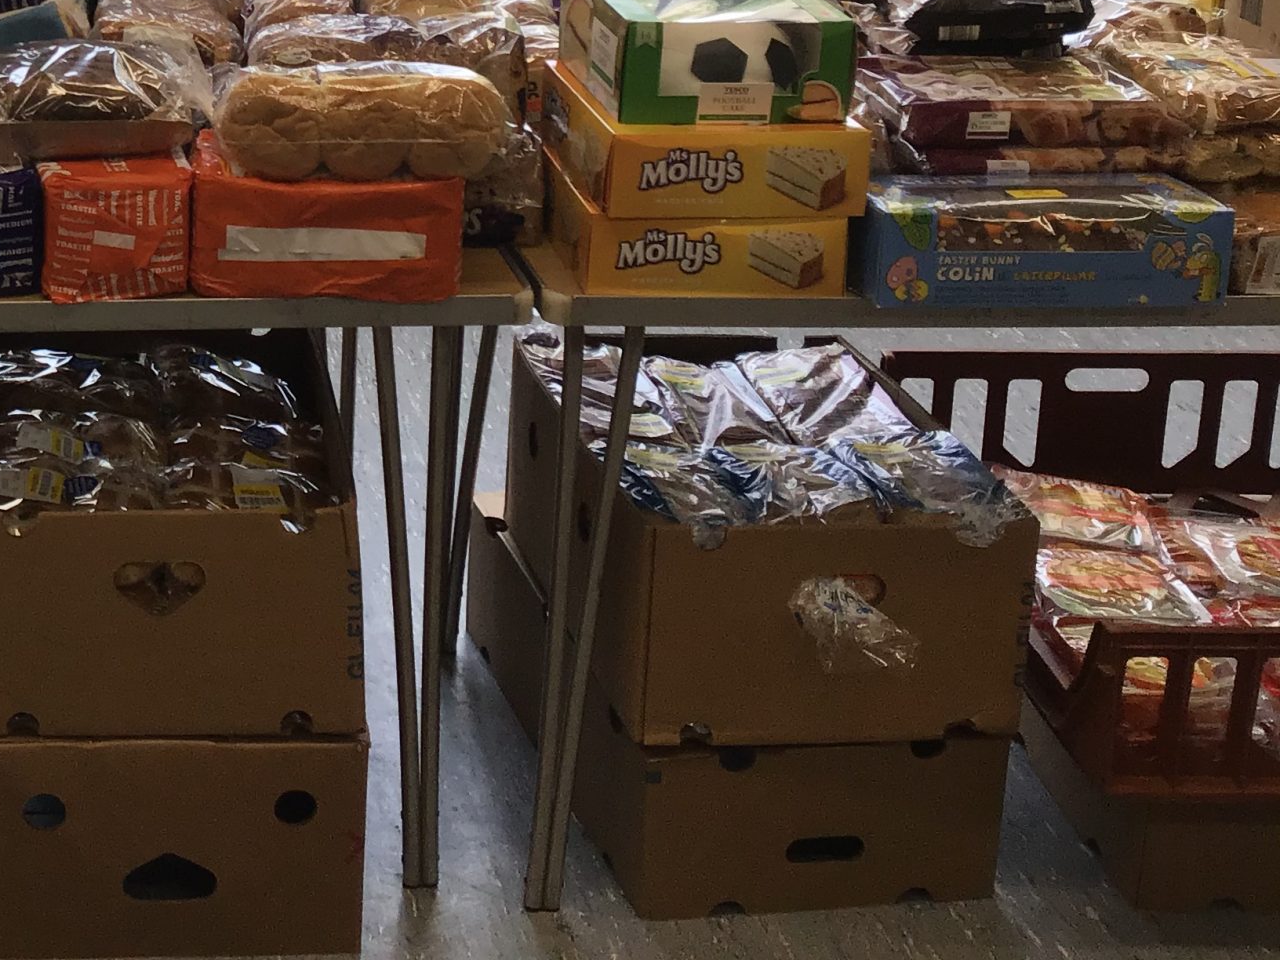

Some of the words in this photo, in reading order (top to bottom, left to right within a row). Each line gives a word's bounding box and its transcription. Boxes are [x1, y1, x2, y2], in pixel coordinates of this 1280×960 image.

[669, 148, 688, 163] Ms
[639, 150, 743, 193] Molly's
[61, 203, 97, 215] TOASTIE
[135, 191, 144, 227] TOASTIE
[0, 219, 34, 231] MEDIUM
[646, 229, 665, 244] Ms
[55, 239, 92, 252] TOASTIE
[615, 232, 721, 274] Molly's
[937, 255, 978, 266] EASTER
[981, 255, 1021, 266] BUNNY
[150, 265, 185, 278] TOASTIE
